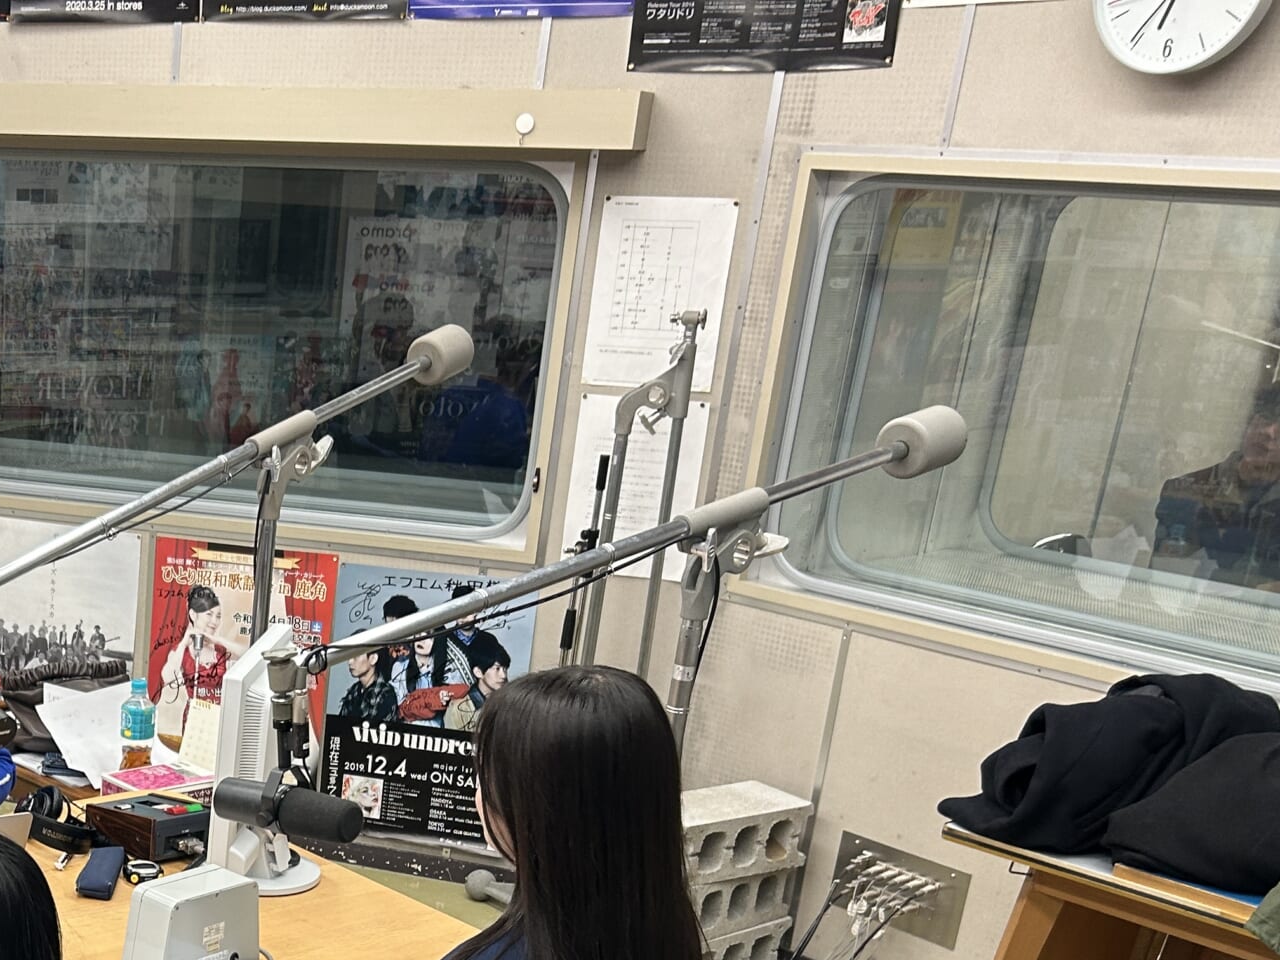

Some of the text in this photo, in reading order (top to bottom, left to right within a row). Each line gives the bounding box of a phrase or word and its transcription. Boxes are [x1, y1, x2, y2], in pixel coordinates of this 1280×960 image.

[117, 2, 143, 10] stores
[646, 9, 695, 20] ワタリドリ
[1162, 38, 1174, 58] 6
[278, 579, 328, 602] in 鹿角
[233, 612, 252, 625] 令和
[366, 754, 407, 778] 12.4
[410, 773, 428, 782] wed
[433, 763, 458, 773] major
[430, 771, 453, 786] ON
[428, 820, 445, 828] TOKYO
